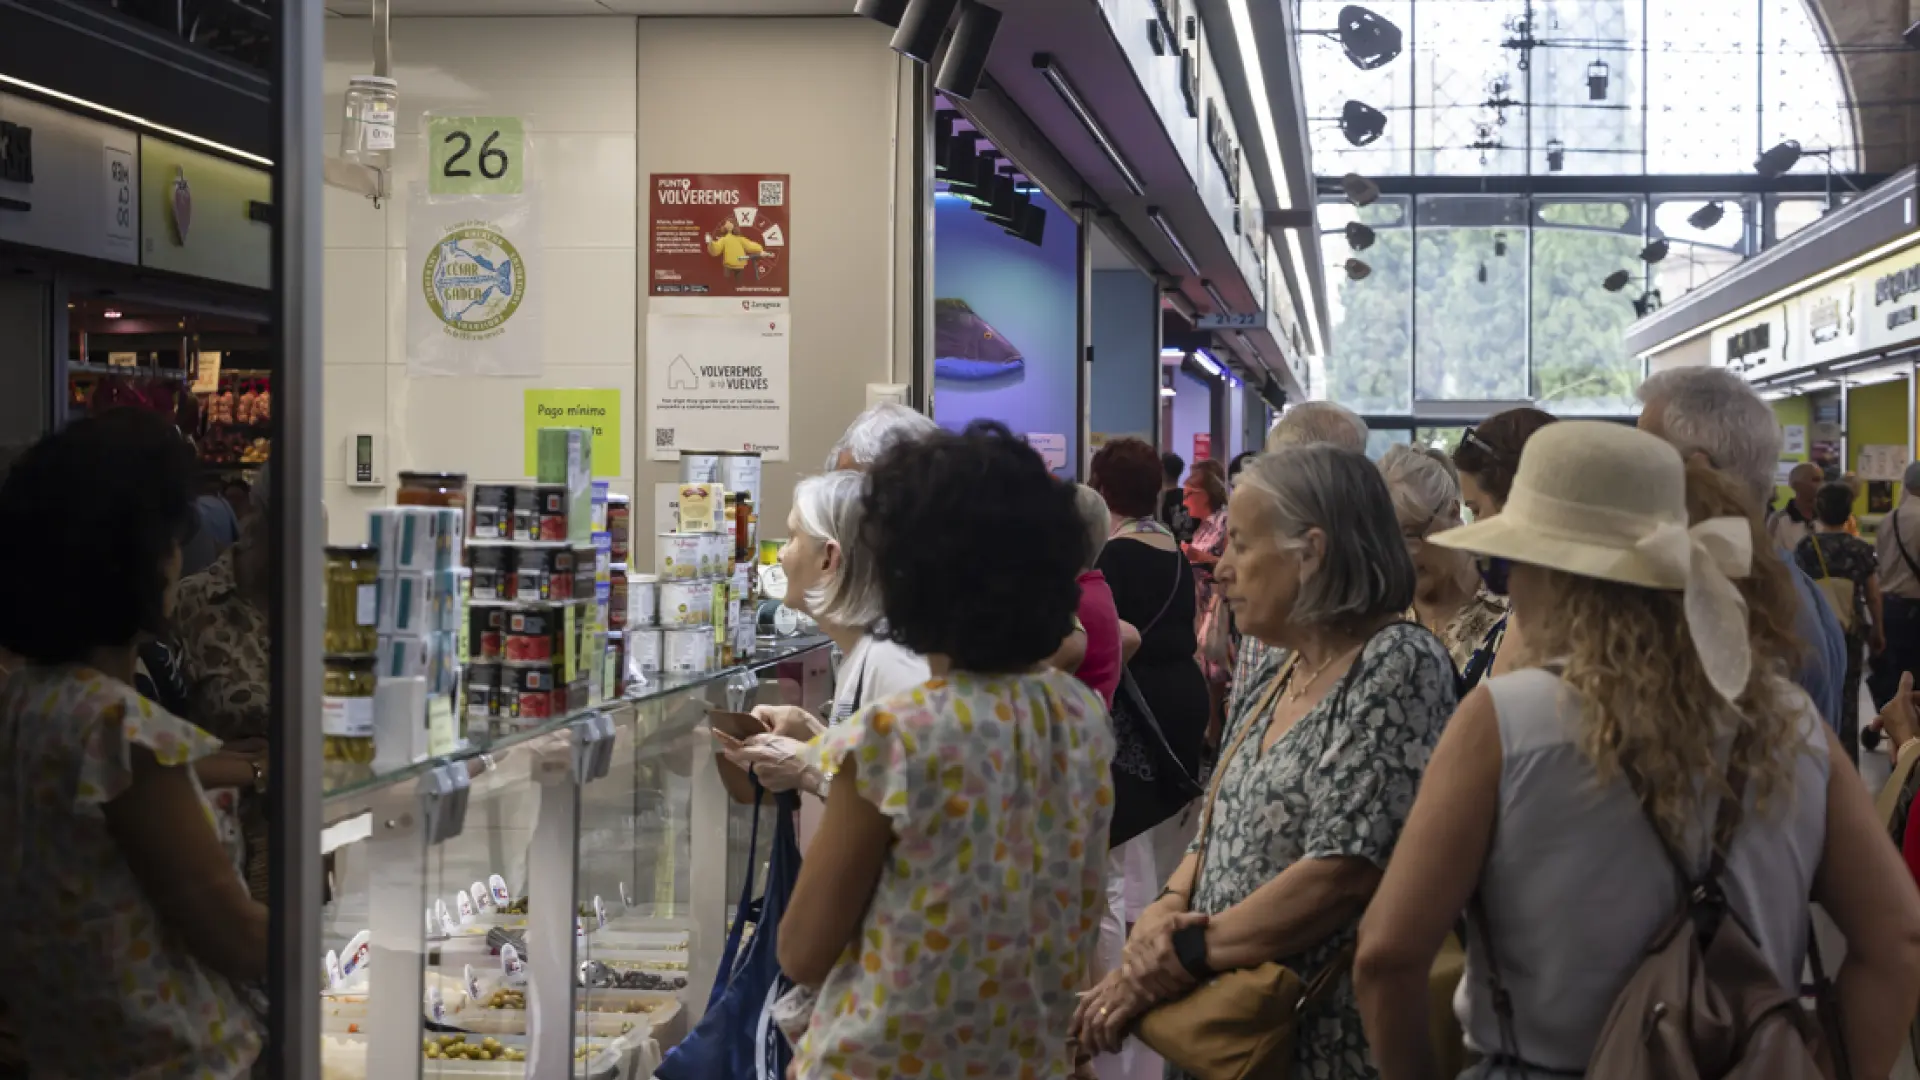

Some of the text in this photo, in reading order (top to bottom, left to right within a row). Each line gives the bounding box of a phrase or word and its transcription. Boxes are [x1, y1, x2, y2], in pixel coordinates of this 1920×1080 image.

[443, 130, 509, 179] 26
[658, 189, 740, 205] VOLVEREMOS
[750, 301, 781, 309] Zaragoza
[700, 365, 762, 377] VOLVEREMOS
[726, 378, 769, 390] VUELVES
[537, 403, 607, 419] Pago mínimo
